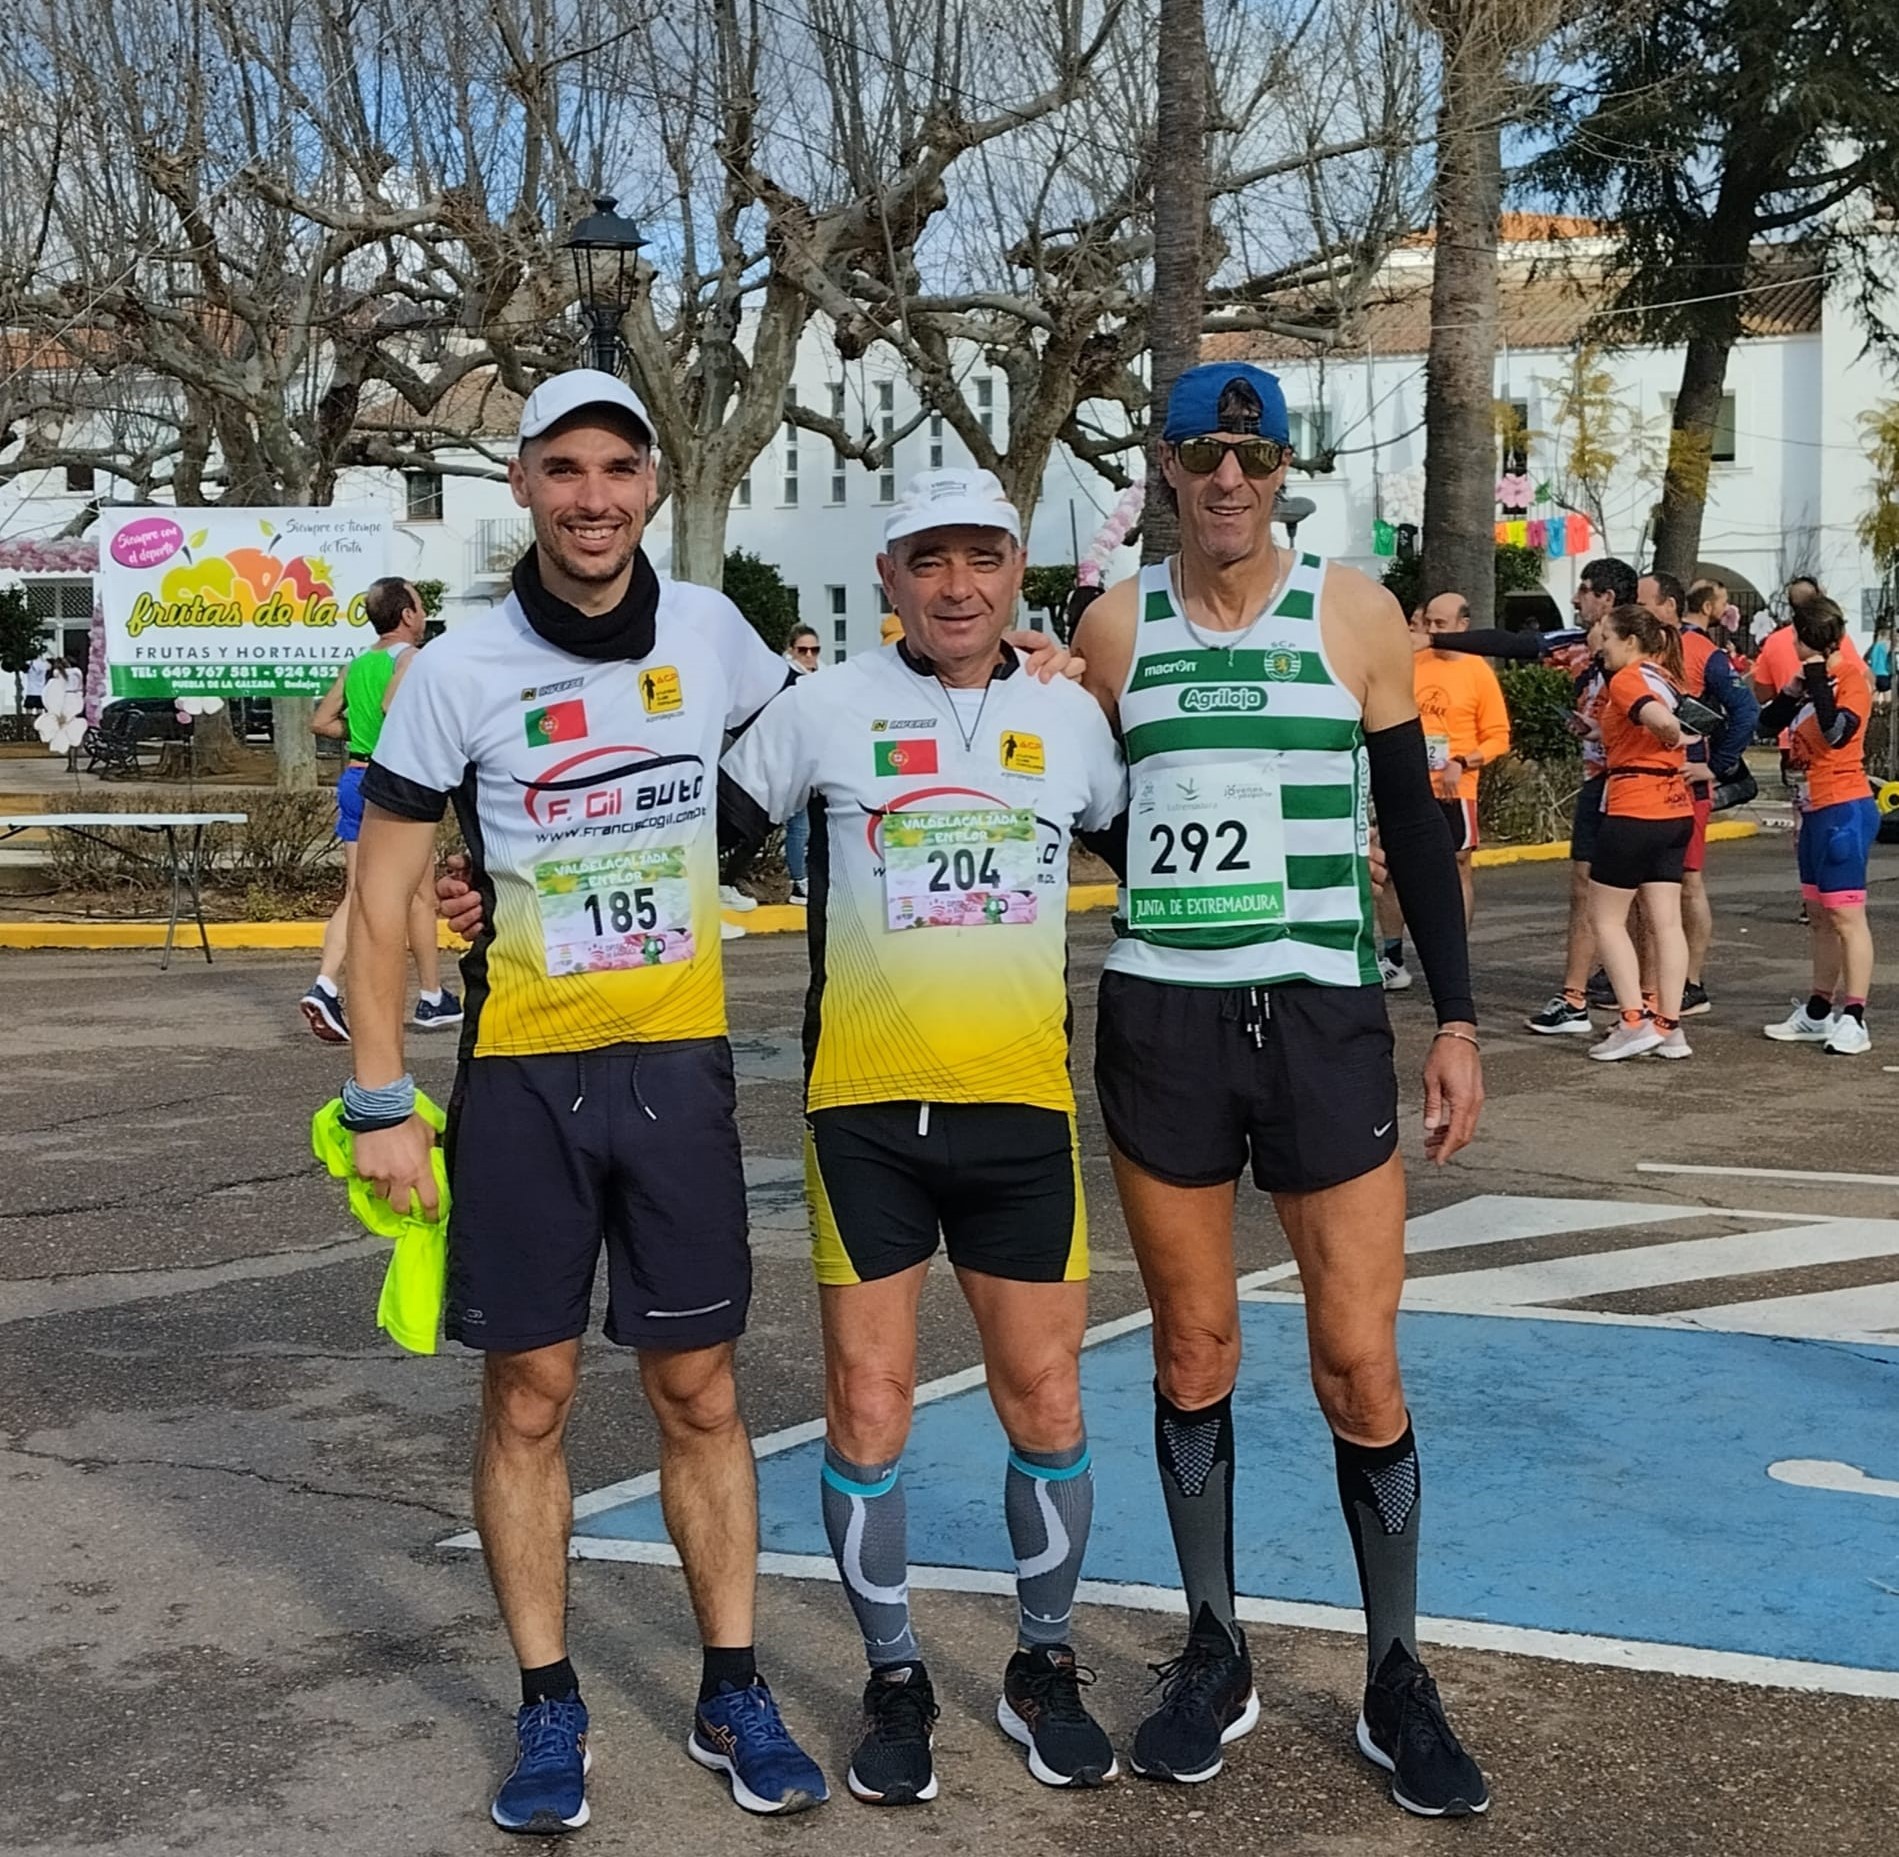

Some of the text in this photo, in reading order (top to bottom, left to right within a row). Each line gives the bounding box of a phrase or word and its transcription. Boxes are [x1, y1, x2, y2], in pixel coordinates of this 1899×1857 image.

[286, 518, 382, 536] Siempre es tiempo
[139, 542, 174, 562] deporte
[319, 541, 332, 554] de
[127, 592, 243, 637] frutas
[253, 591, 294, 627] de
[304, 592, 338, 627] la
[135, 646, 366, 660] FRUTAS Y HORTALIZA
[130, 666, 157, 678] TEL:
[161, 666, 192, 678] 649
[195, 666, 225, 678] 767
[230, 666, 257, 678] 581
[274, 666, 304, 678] 924
[309, 666, 339, 678] 452
[1144, 659, 1198, 677] macron
[221, 680, 233, 689] LA
[1184, 687, 1260, 712] Agriloja
[586, 787, 622, 818] Gil
[902, 815, 1018, 830] VALDELACALZADA
[1150, 820, 1251, 874] 292
[555, 851, 669, 876] VALDELACALZADA
[927, 847, 1000, 892] 204
[584, 887, 657, 936] 185
[1136, 894, 1279, 918] JUNTA DE EXTREMADURA
